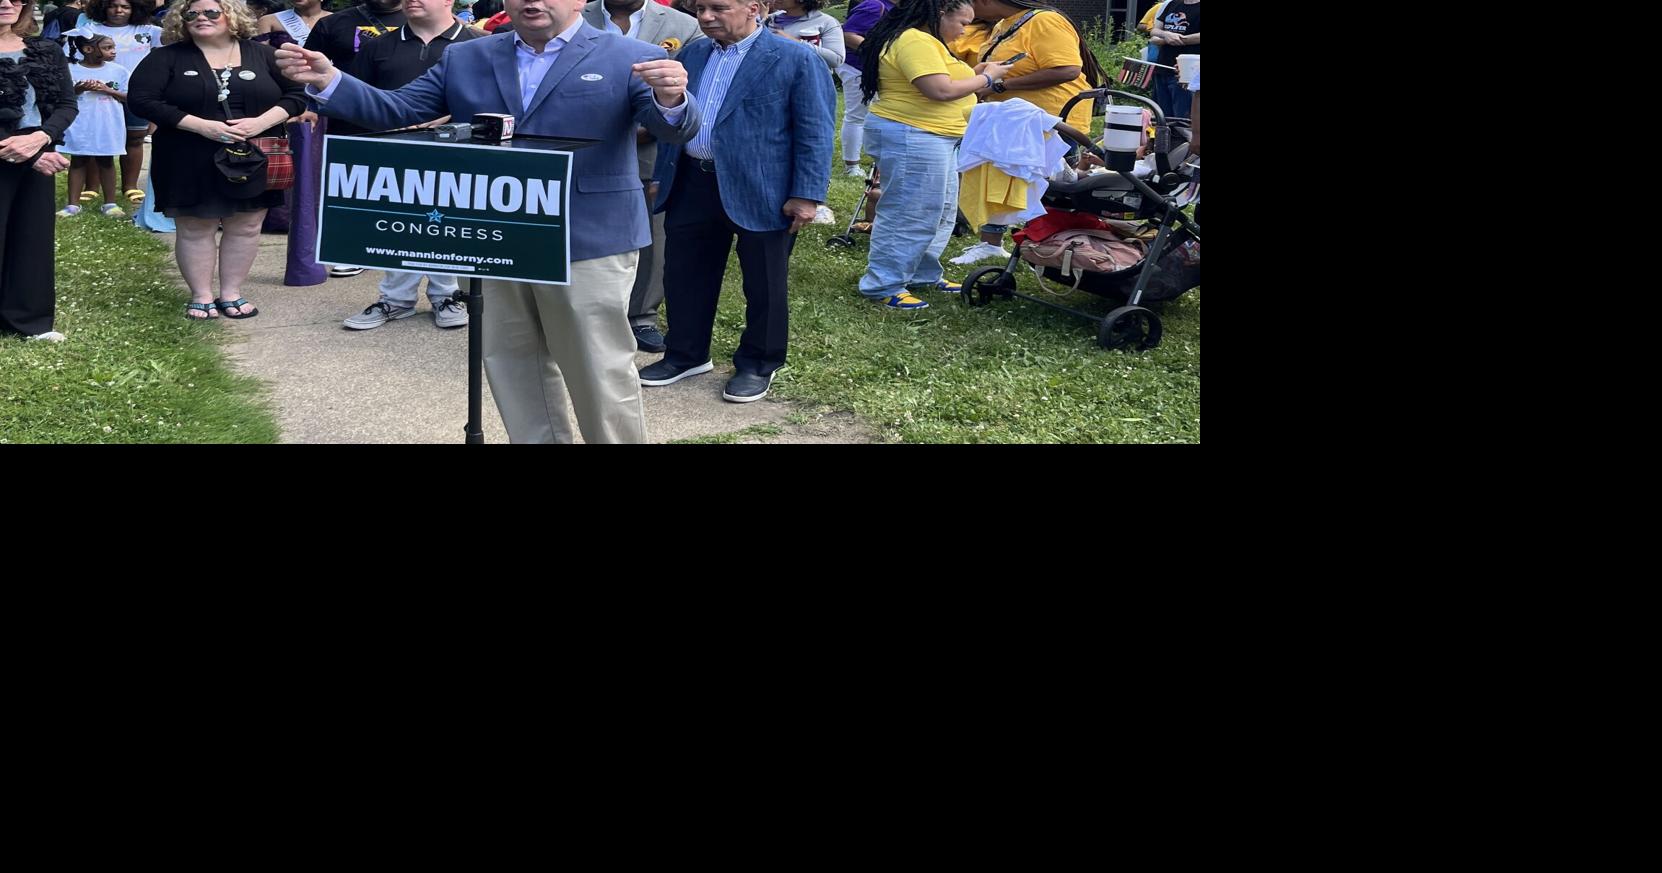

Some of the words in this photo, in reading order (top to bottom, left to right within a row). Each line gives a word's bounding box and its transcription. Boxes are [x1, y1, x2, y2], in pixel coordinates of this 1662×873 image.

[328, 163, 561, 216] MANNION
[376, 219, 503, 241] CONGRESS
[366, 246, 513, 265] www.mannionforny.com
